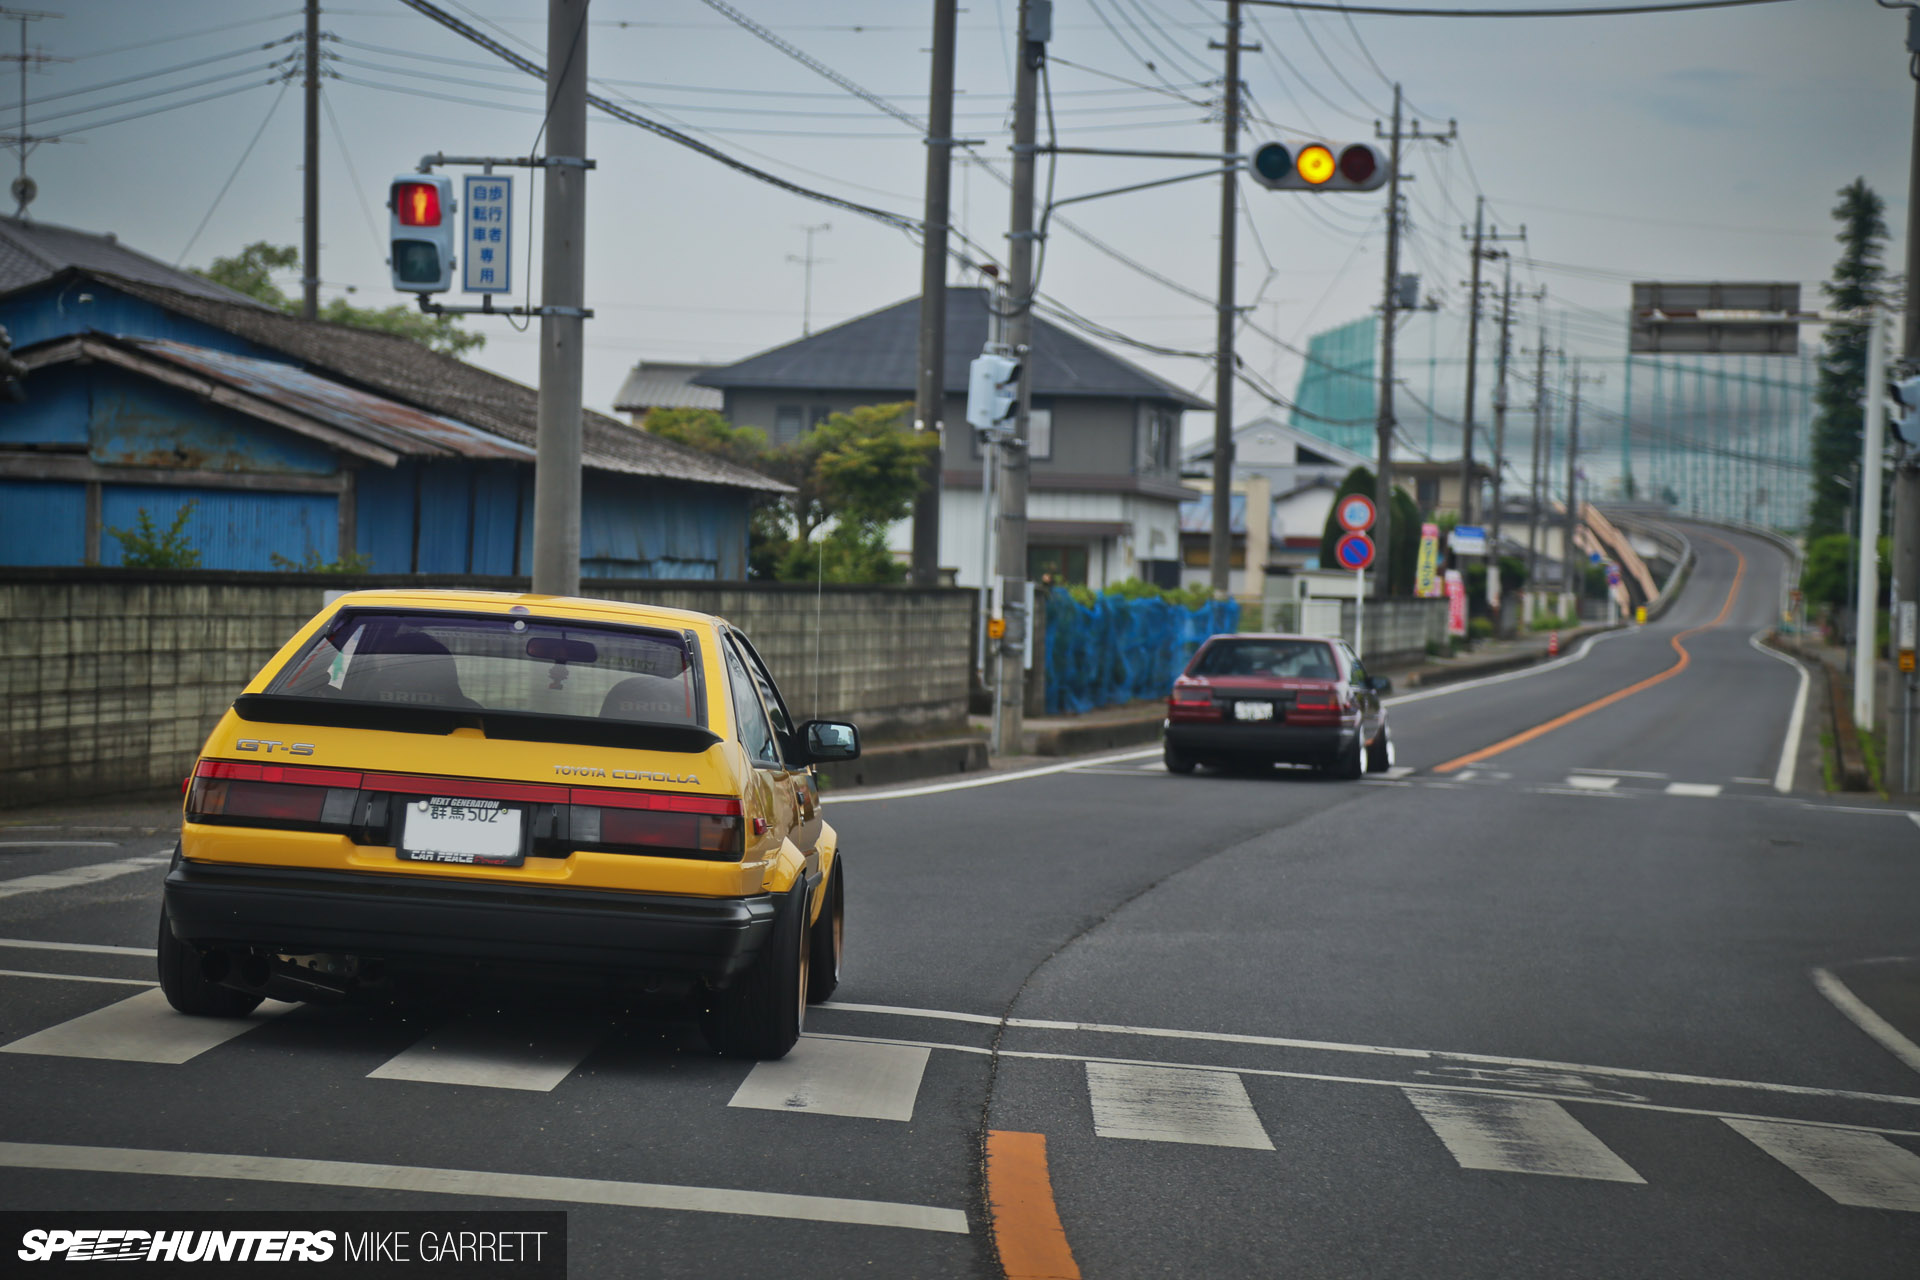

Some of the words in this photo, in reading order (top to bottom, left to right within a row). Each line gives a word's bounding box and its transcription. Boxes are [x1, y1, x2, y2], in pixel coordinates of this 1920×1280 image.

[473, 185, 487, 241] 自転車
[488, 185, 502, 242] 歩行者
[480, 247, 494, 283] 専用
[236, 738, 315, 756] GT-S
[553, 765, 606, 778] TOYOTA
[612, 769, 701, 785] COROLLA
[430, 797, 450, 806] NEXT
[451, 799, 499, 808] GENERATION
[430, 806, 465, 821] 群馬
[467, 808, 499, 823] 502
[411, 850, 434, 860] CAR
[437, 851, 474, 863] PEACE
